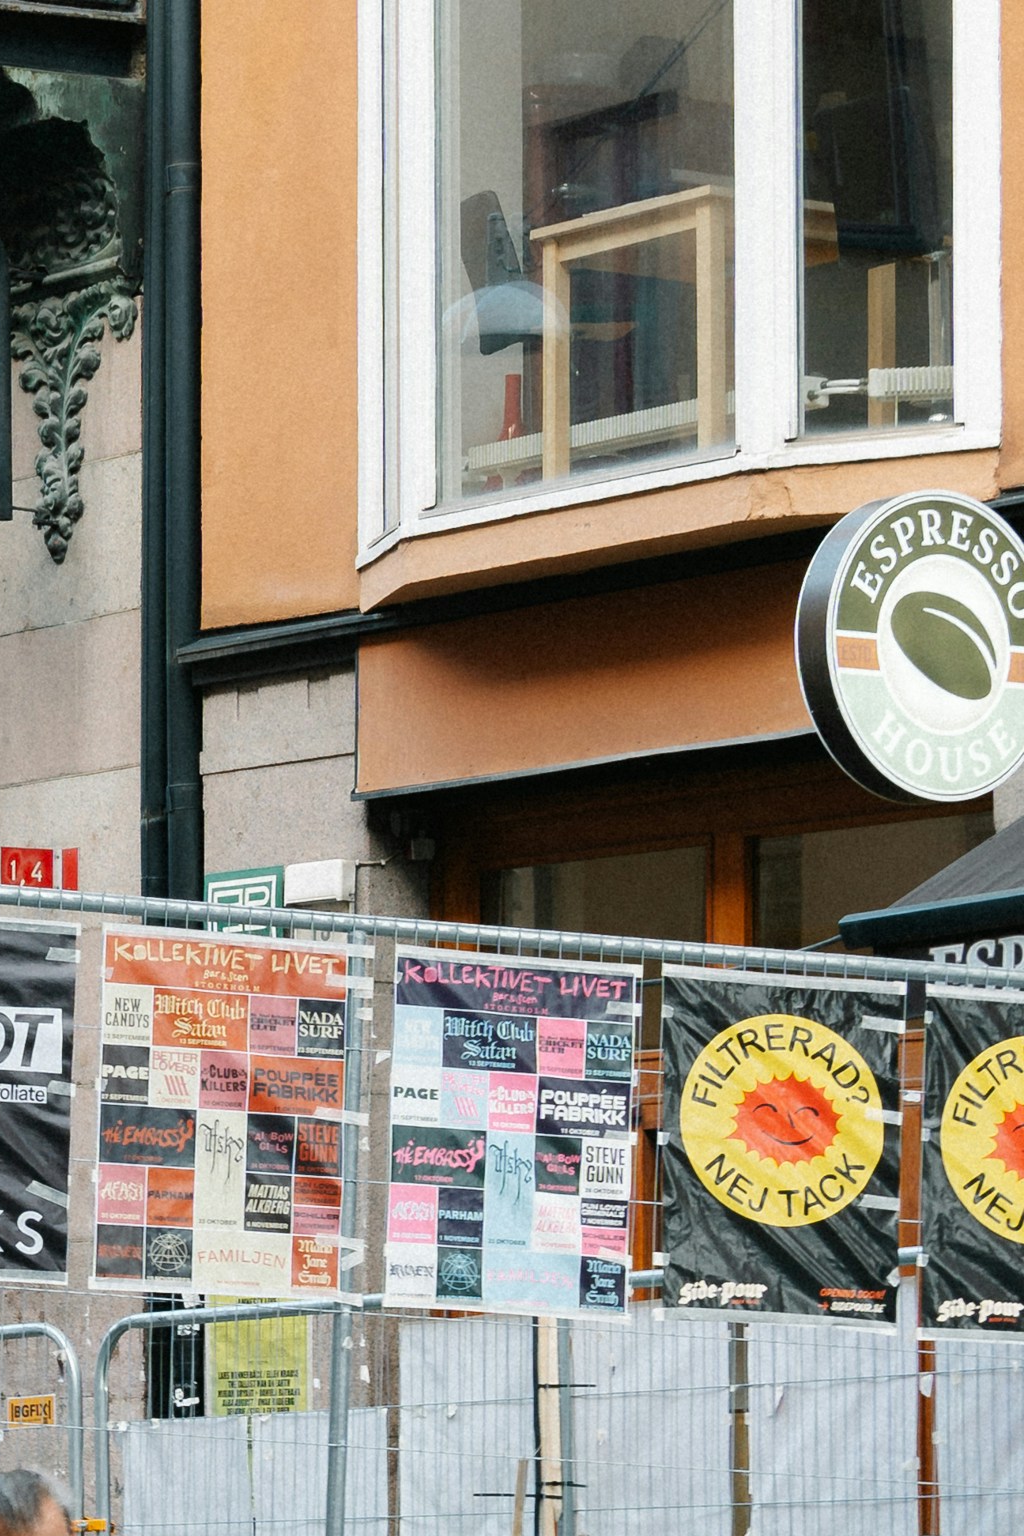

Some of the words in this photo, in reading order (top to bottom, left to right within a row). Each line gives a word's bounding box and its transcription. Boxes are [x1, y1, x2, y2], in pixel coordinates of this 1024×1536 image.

[850, 508, 1024, 620] ESPRESSO
[871, 711, 1018, 783] HOUSE
[271, 953, 340, 976] LIVET
[203, 969, 220, 980] Bar
[194, 981, 260, 992] STOCKHOLM
[559, 975, 627, 999] LIVET
[114, 997, 141, 1012] NEW
[154, 994, 203, 1018] Witch
[206, 998, 246, 1020] Club
[483, 1003, 549, 1016] STOCKHOLM
[105, 1012, 149, 1028] CANDYS
[298, 1010, 344, 1025] NADA
[171, 1017, 227, 1038] Satan
[298, 1024, 344, 1039] SURF
[444, 1016, 494, 1042] Witch
[496, 1020, 535, 1042] Club
[187, 1038, 227, 1047] SEPTEMBER
[587, 1033, 632, 1048] NADA
[152, 1050, 198, 1062] BETTER
[306, 1047, 344, 1055] SEPTEMBER
[461, 1039, 517, 1060] Satan
[587, 1046, 632, 1061] SURF
[102, 1064, 150, 1080] PAGE
[152, 1060, 198, 1075] LOVERS
[209, 1064, 239, 1079] CLUB
[477, 1061, 516, 1069] SEPTEMBER
[691, 1023, 870, 1108] FILTRERAD?
[254, 1066, 339, 1087] POUPPÉE
[593, 1069, 631, 1078] SEPTEMBER
[201, 1078, 247, 1092] KILLERS
[253, 1082, 339, 1103] FABRIKK
[393, 1086, 439, 1100] PAGE
[498, 1086, 527, 1101] CLUB
[540, 1089, 626, 1110] POUPPÉE
[212, 1100, 242, 1108] OKTOBER
[489, 1100, 534, 1115] KILLERS
[540, 1105, 625, 1126] FABRIKK
[298, 1123, 339, 1144] STEVE
[569, 1129, 600, 1137] OKTOBER
[299, 1142, 338, 1163] GUNN
[585, 1145, 625, 1166] STEVE
[586, 1165, 624, 1185] GUNN
[248, 1183, 290, 1201] MATTIAS
[705, 1153, 769, 1213] NEJ
[777, 1153, 866, 1217] TACK
[148, 1190, 193, 1200] PARHAM
[963, 1172, 1024, 1232] NEJ
[245, 1198, 290, 1215] ALKBERG
[206, 1218, 237, 1226] OKTOBER
[294, 1211, 339, 1220] SCHILLER
[439, 1210, 483, 1221] PARHAM
[252, 1221, 289, 1230] NOVEMBER
[197, 1249, 287, 1270] FAMILJEN
